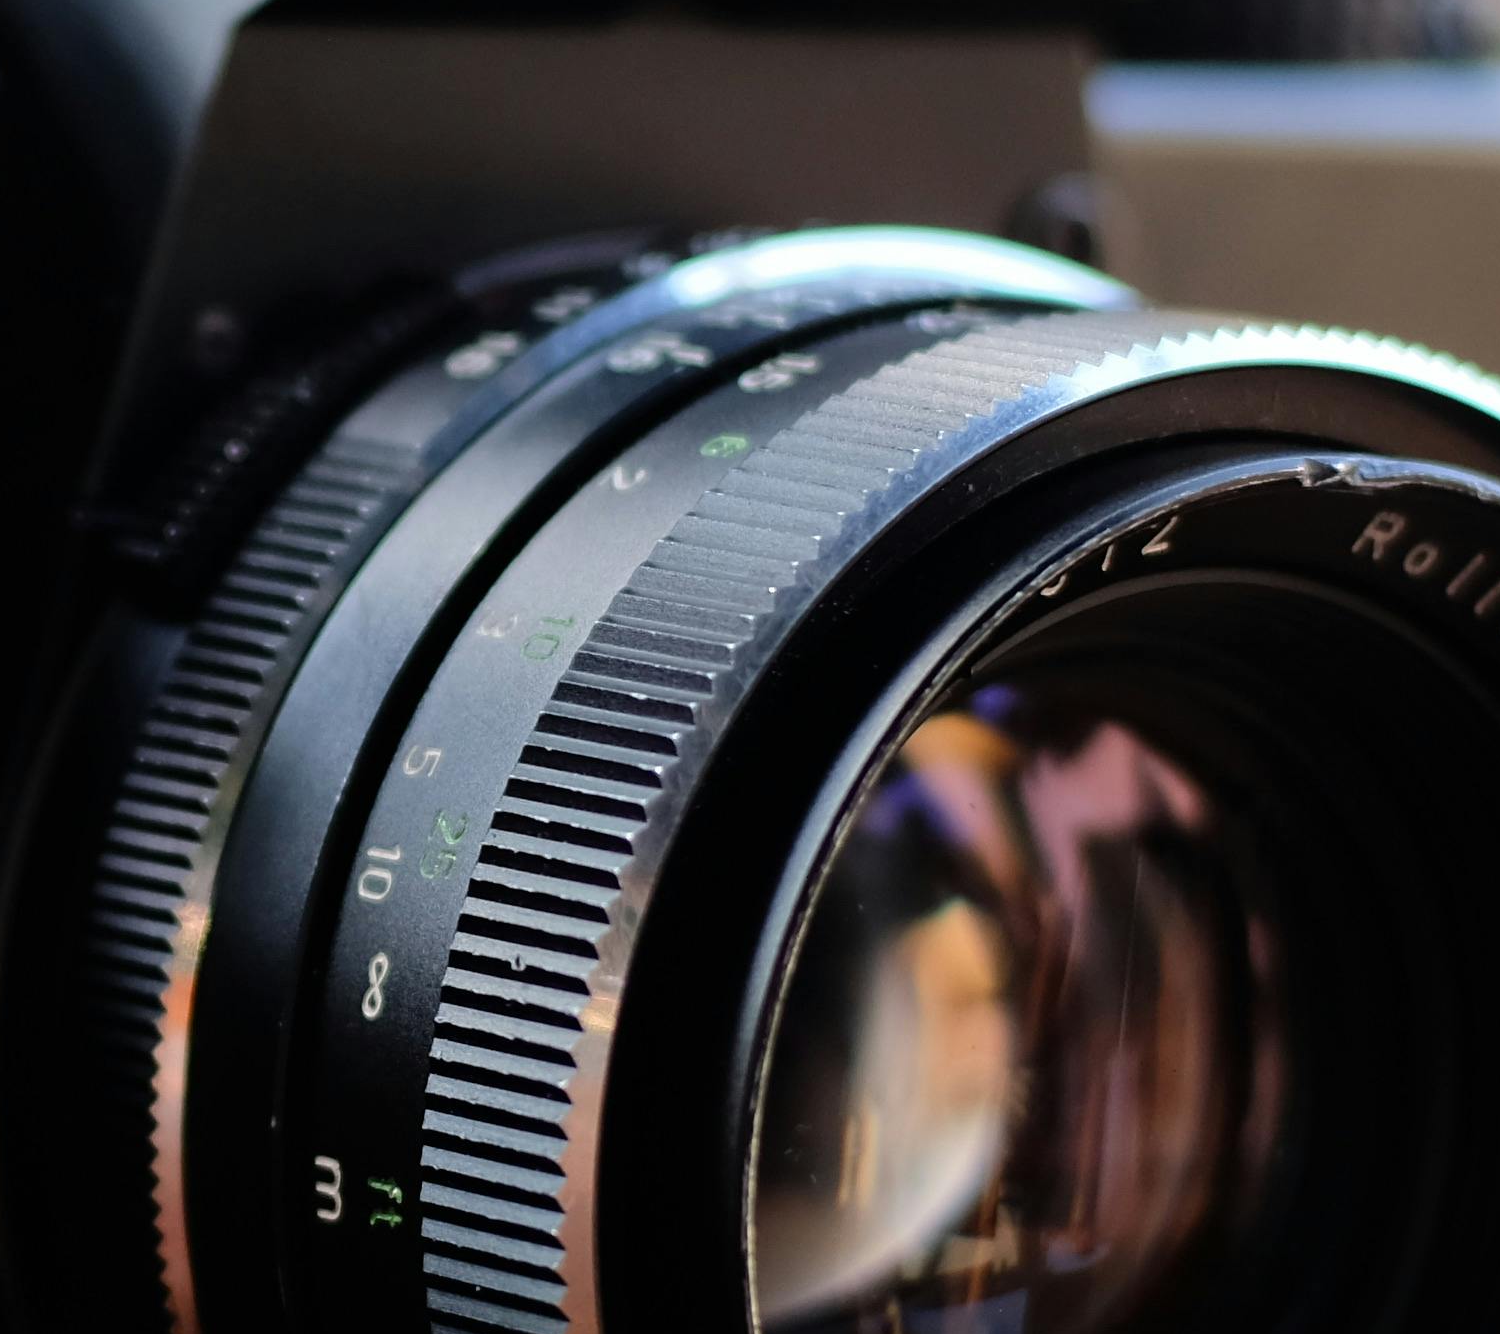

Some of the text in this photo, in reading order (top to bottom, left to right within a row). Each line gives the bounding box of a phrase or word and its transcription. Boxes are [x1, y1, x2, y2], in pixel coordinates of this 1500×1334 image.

[607, 466, 647, 491] 2
[520, 615, 576, 661] 10
[402, 744, 441, 779] 5
[419, 810, 469, 881] 25
[357, 845, 401, 902] 10
[314, 1155, 343, 1222] m
[367, 1177, 403, 1227] ft
